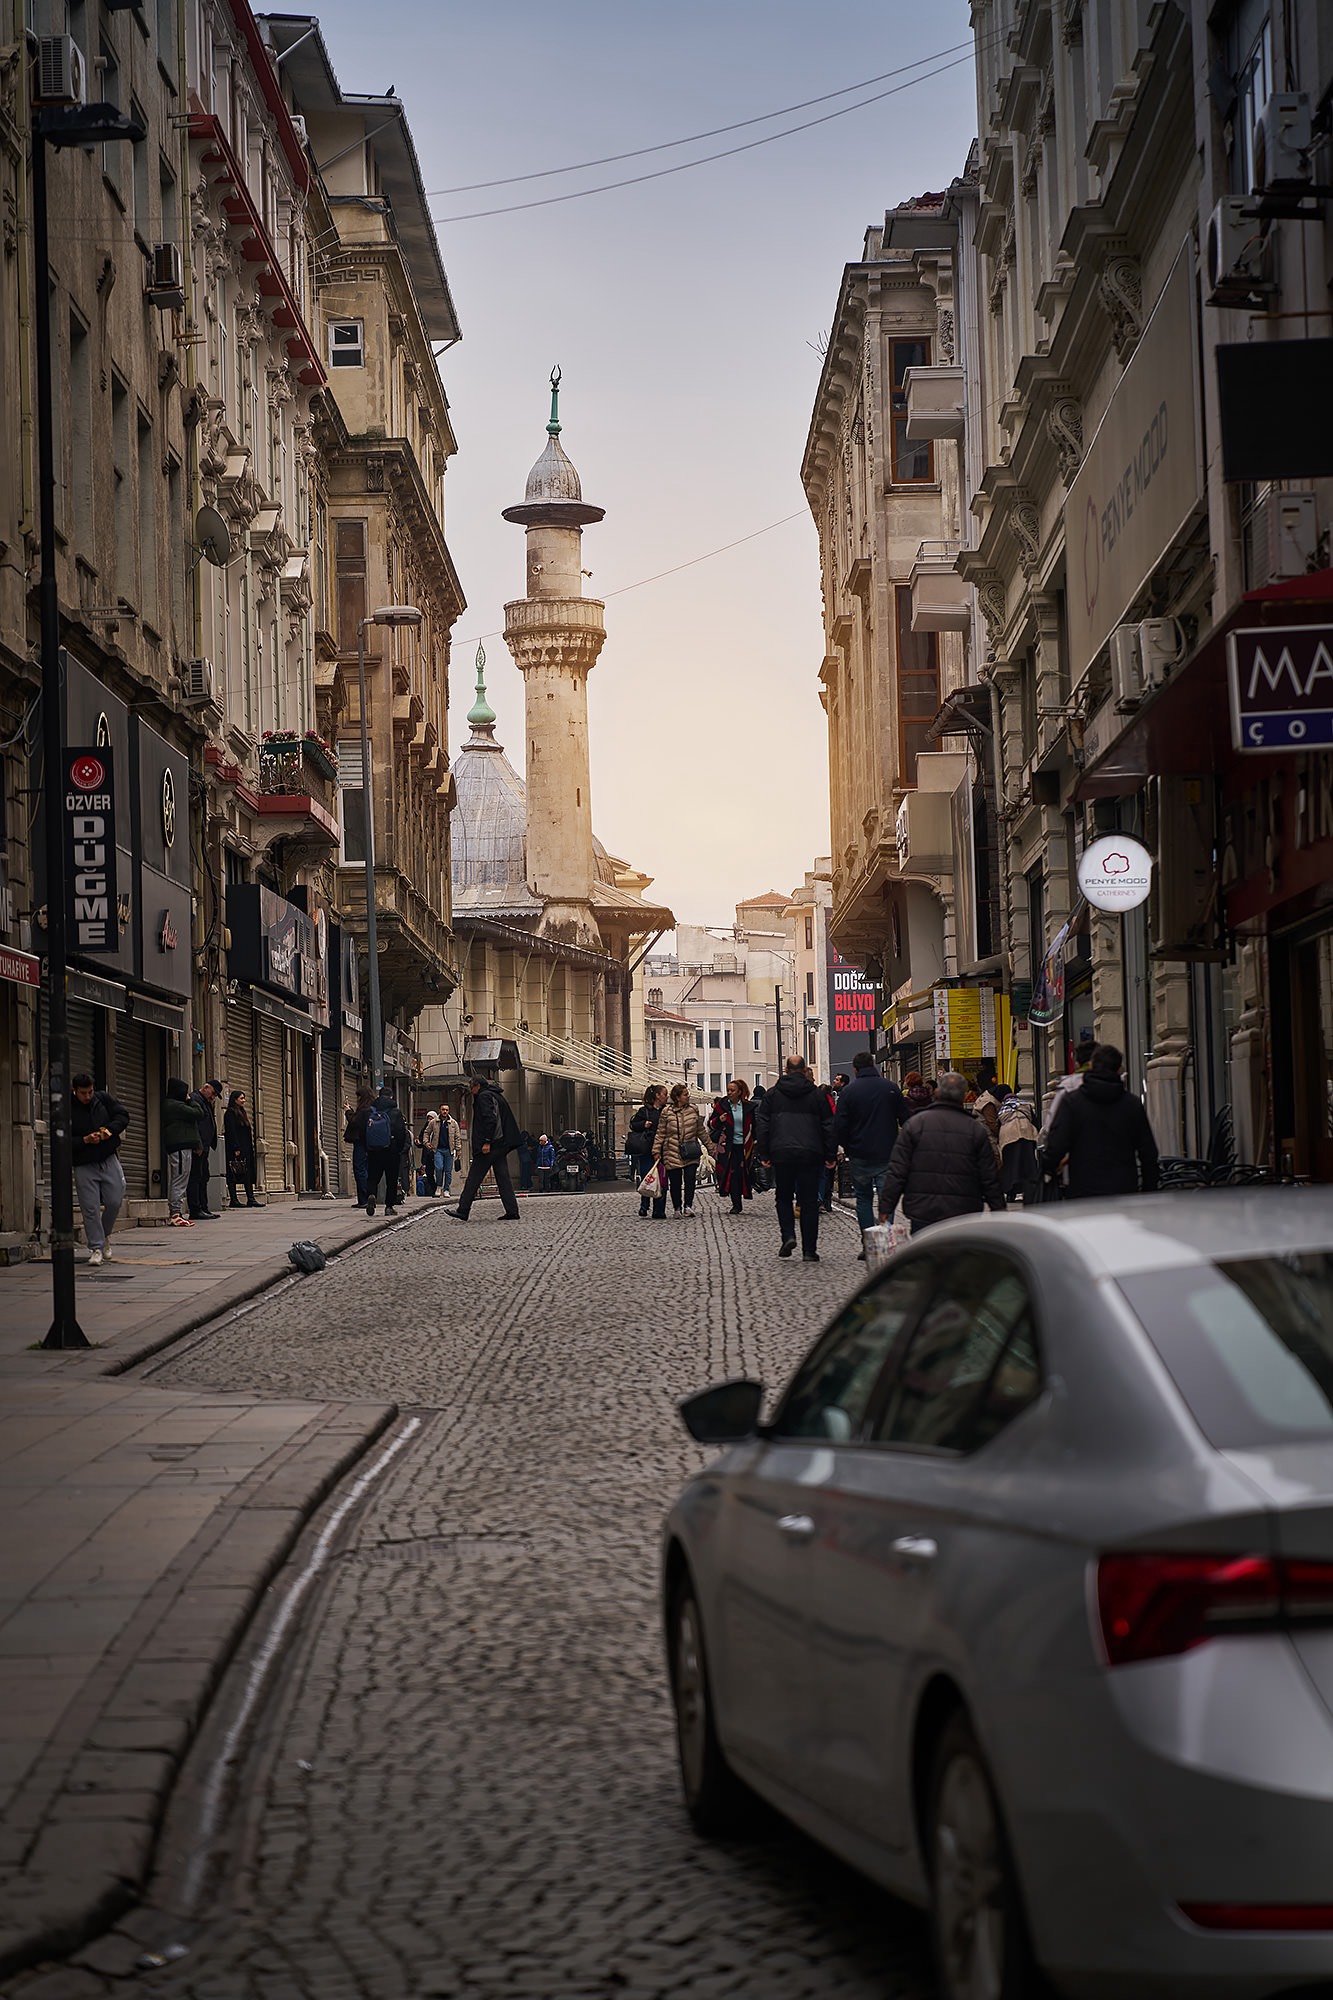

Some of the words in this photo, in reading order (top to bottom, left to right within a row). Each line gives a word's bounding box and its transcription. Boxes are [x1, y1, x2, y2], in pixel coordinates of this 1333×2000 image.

[1101, 463, 1133, 563] PENYE
[1133, 400, 1168, 506] MOOD
[1248, 719, 1333, 746] ÇO
[66, 792, 111, 811] ÖZVER
[73, 816, 108, 945] DÜĞME
[835, 1012, 868, 1032] DEĞİL
